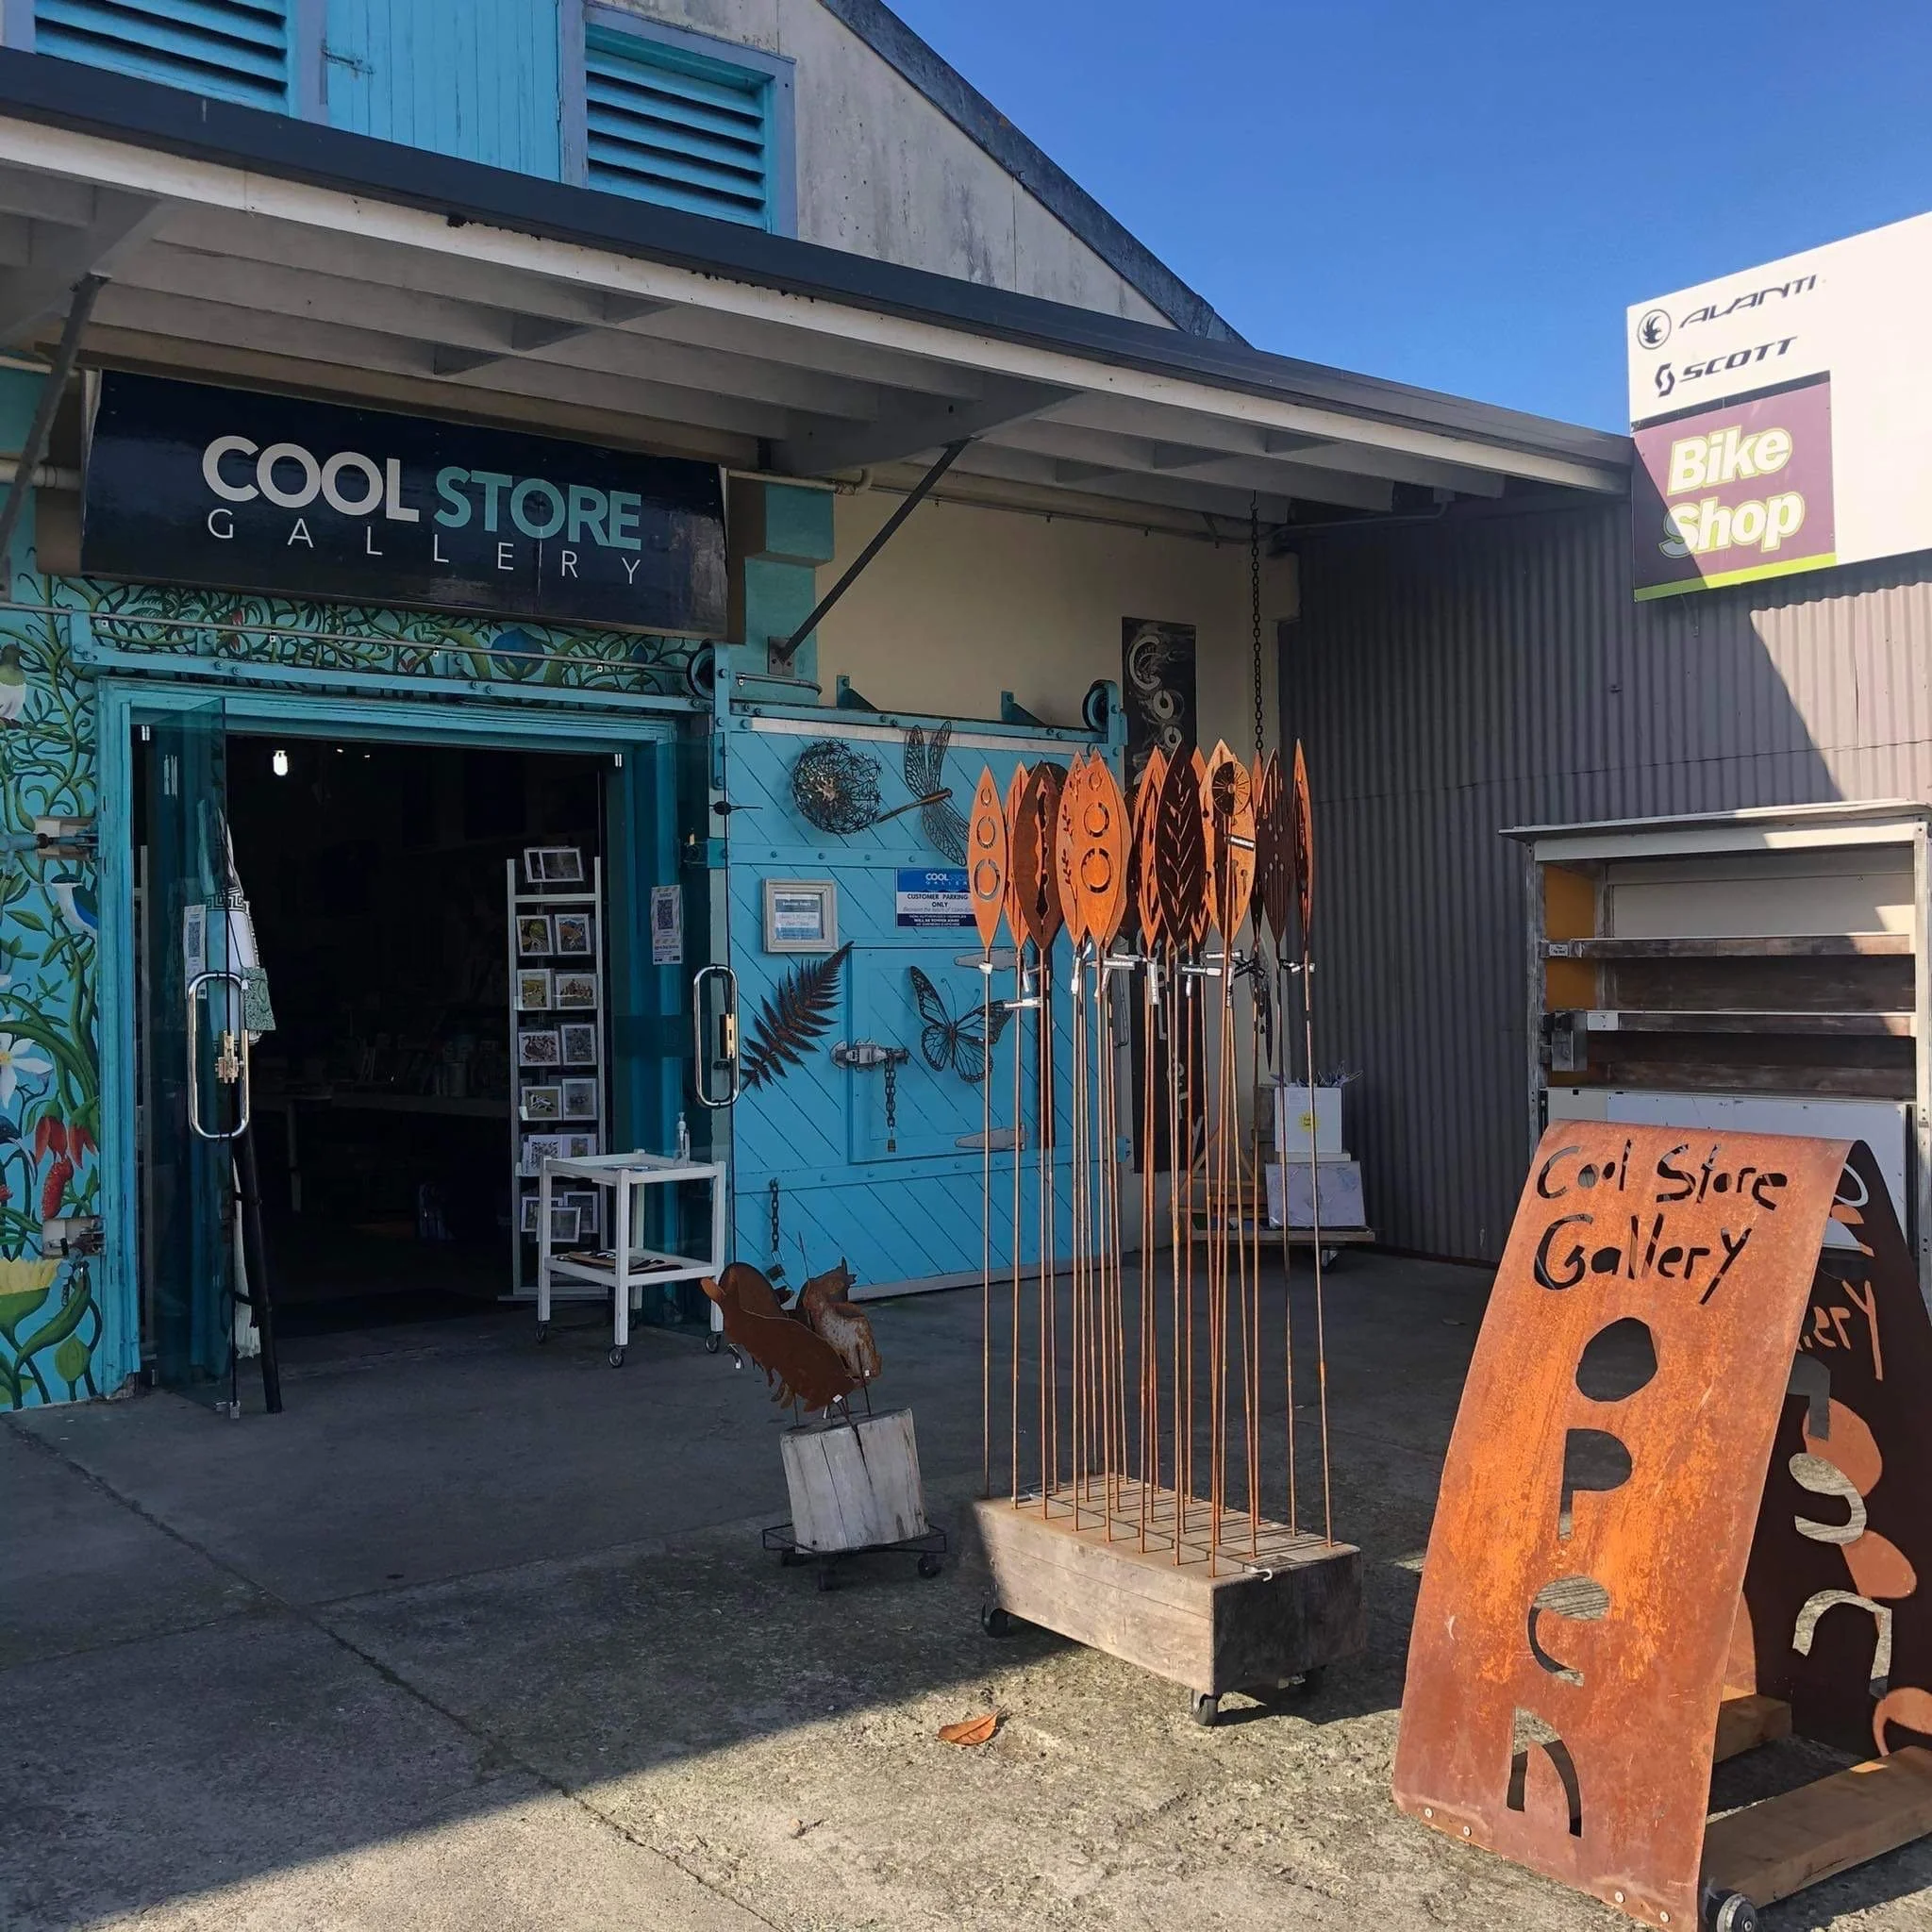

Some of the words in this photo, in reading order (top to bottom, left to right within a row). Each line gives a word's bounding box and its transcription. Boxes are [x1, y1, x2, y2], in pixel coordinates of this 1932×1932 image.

[1679, 275, 1817, 328] AVANTI
[1679, 336, 1798, 383] SCOTT
[201, 435, 421, 524] COOL
[433, 465, 642, 551] STORE
[1667, 425, 1793, 496] Bike
[207, 508, 641, 585] GALLERY
[1658, 491, 1806, 559] Shop
[925, 873, 949, 881] COOL
[1536, 1140, 1632, 1202] Cool
[1656, 1141, 1790, 1211] Store
[1533, 1212, 1754, 1306] Gallery
